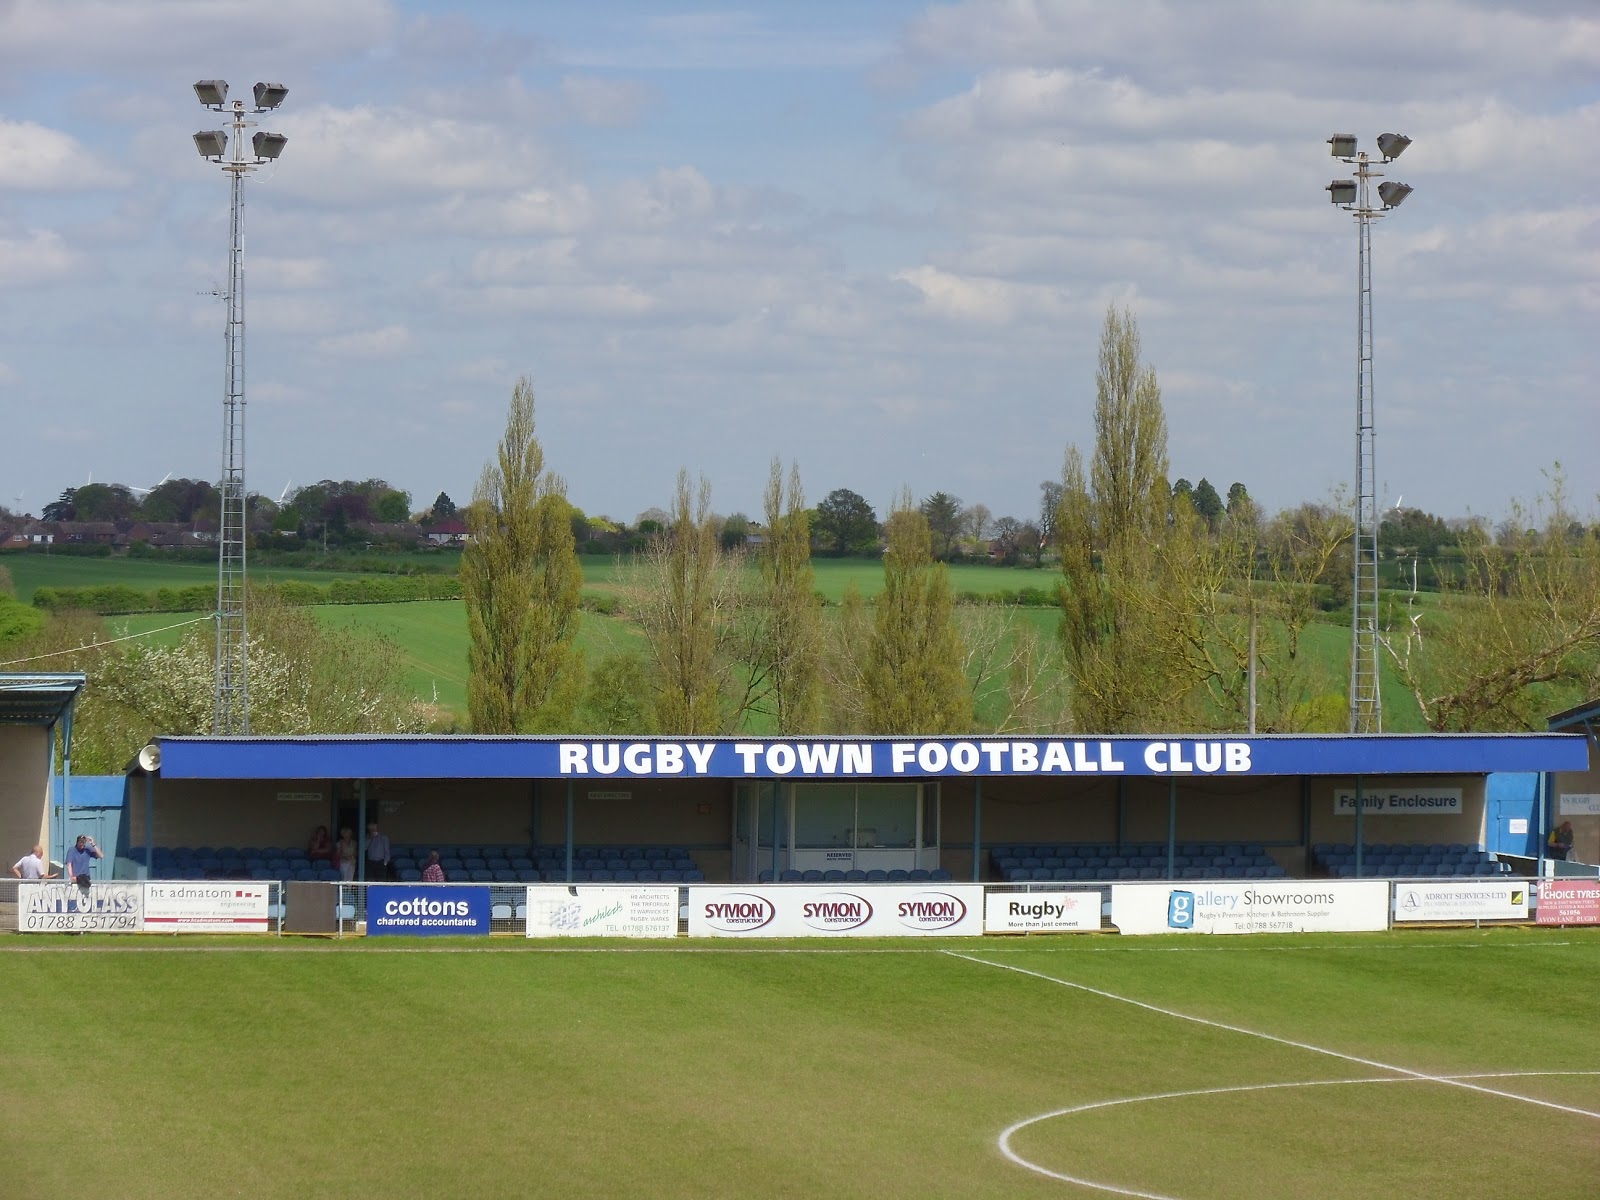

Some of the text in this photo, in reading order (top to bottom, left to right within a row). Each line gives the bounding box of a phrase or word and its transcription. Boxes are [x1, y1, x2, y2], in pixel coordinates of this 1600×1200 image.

[559, 742, 1252, 774] RUGBY TOWN FOOTBALL CLUB
[1389, 795, 1457, 807] Enclosure
[150, 886, 232, 898] ht admatom
[1243, 890, 1335, 905] Showrooms
[1544, 890, 1575, 900] CHOICE
[1576, 889, 1600, 899] TYRES
[27, 885, 74, 914] ANY
[385, 897, 469, 916] cottons
[705, 903, 763, 918] SYMON
[803, 902, 861, 918] SYMON
[898, 902, 955, 917] SYMON
[1009, 901, 1065, 919] Rugby
[1199, 912, 1221, 920] Rugby's
[1307, 910, 1330, 918] Supplier
[27, 916, 137, 929] 01788 551794
[376, 917, 477, 926] chartered accountants
[622, 924, 644, 932] 01788
[645, 924, 670, 932] 576137
[1234, 922, 1246, 930] Tel:
